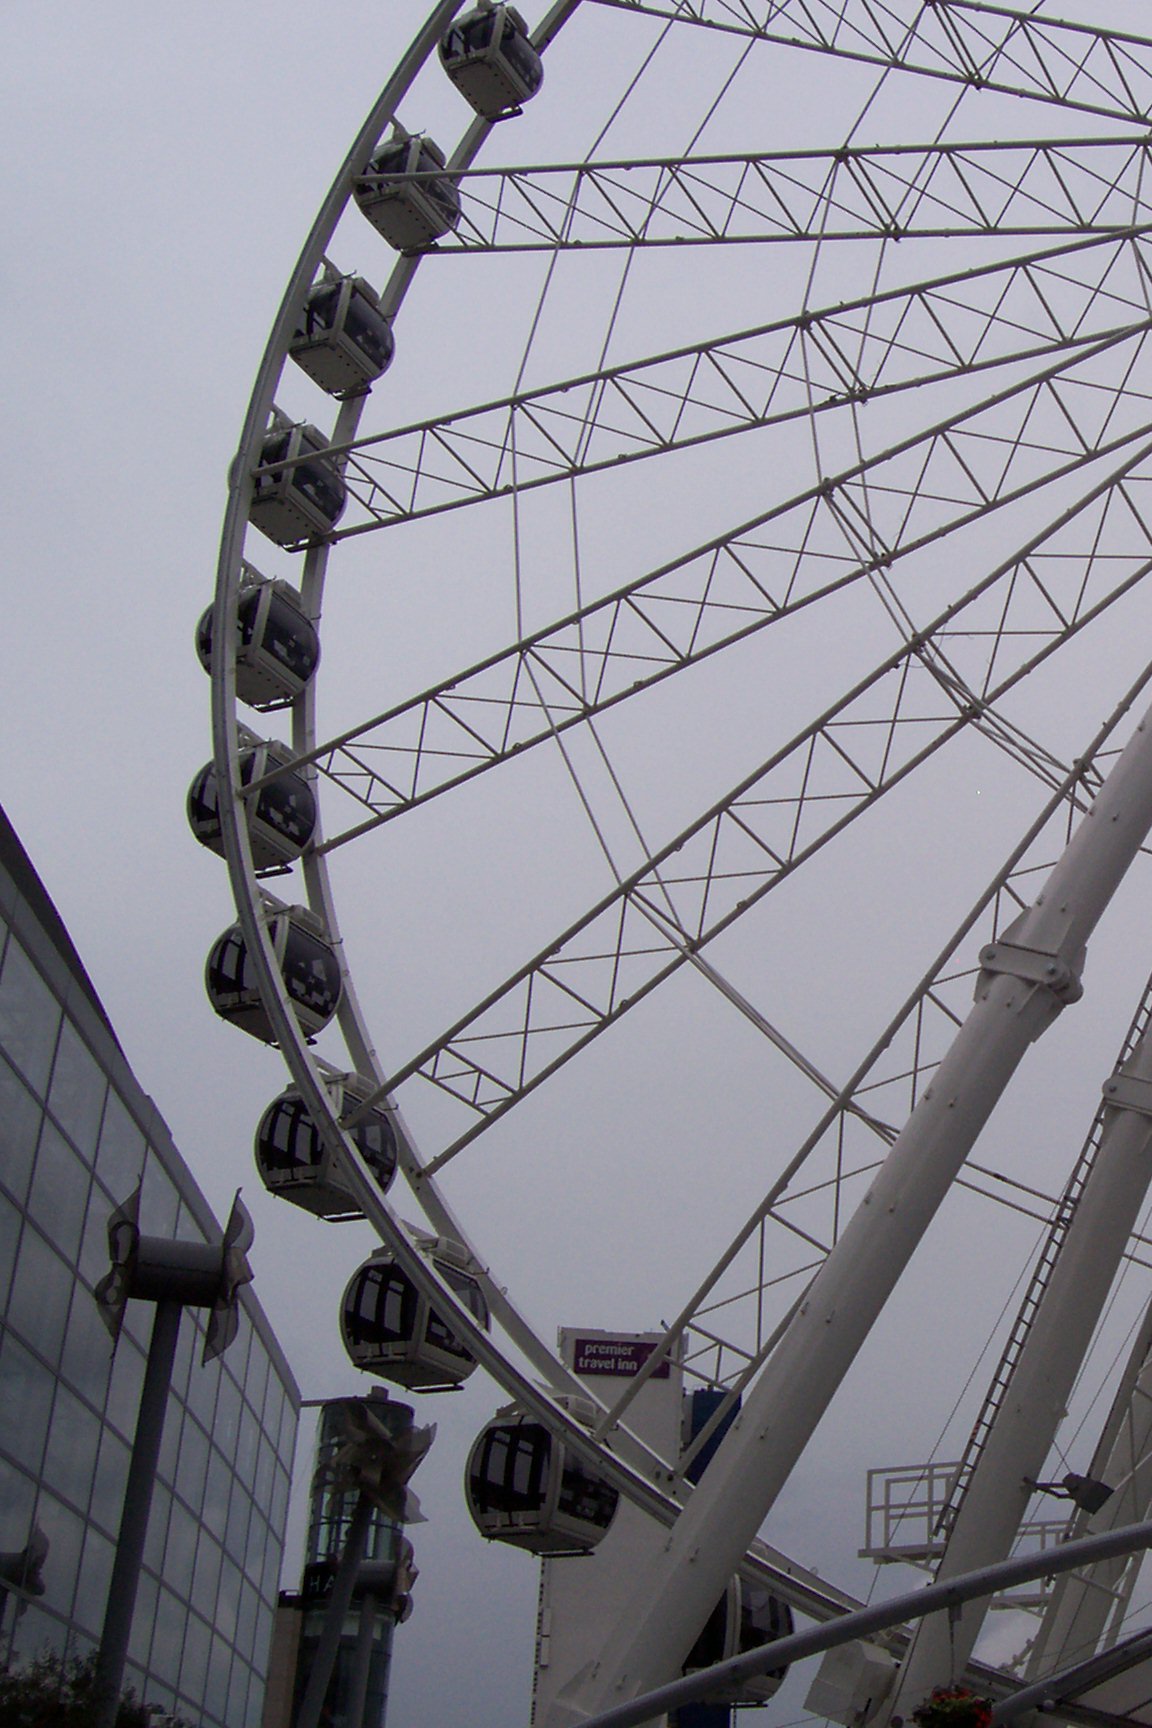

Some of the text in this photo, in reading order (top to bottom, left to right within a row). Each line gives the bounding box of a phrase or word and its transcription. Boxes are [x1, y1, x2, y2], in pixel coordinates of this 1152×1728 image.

[584, 1344, 635, 1356] premier
[578, 1357, 638, 1371] travel inn
